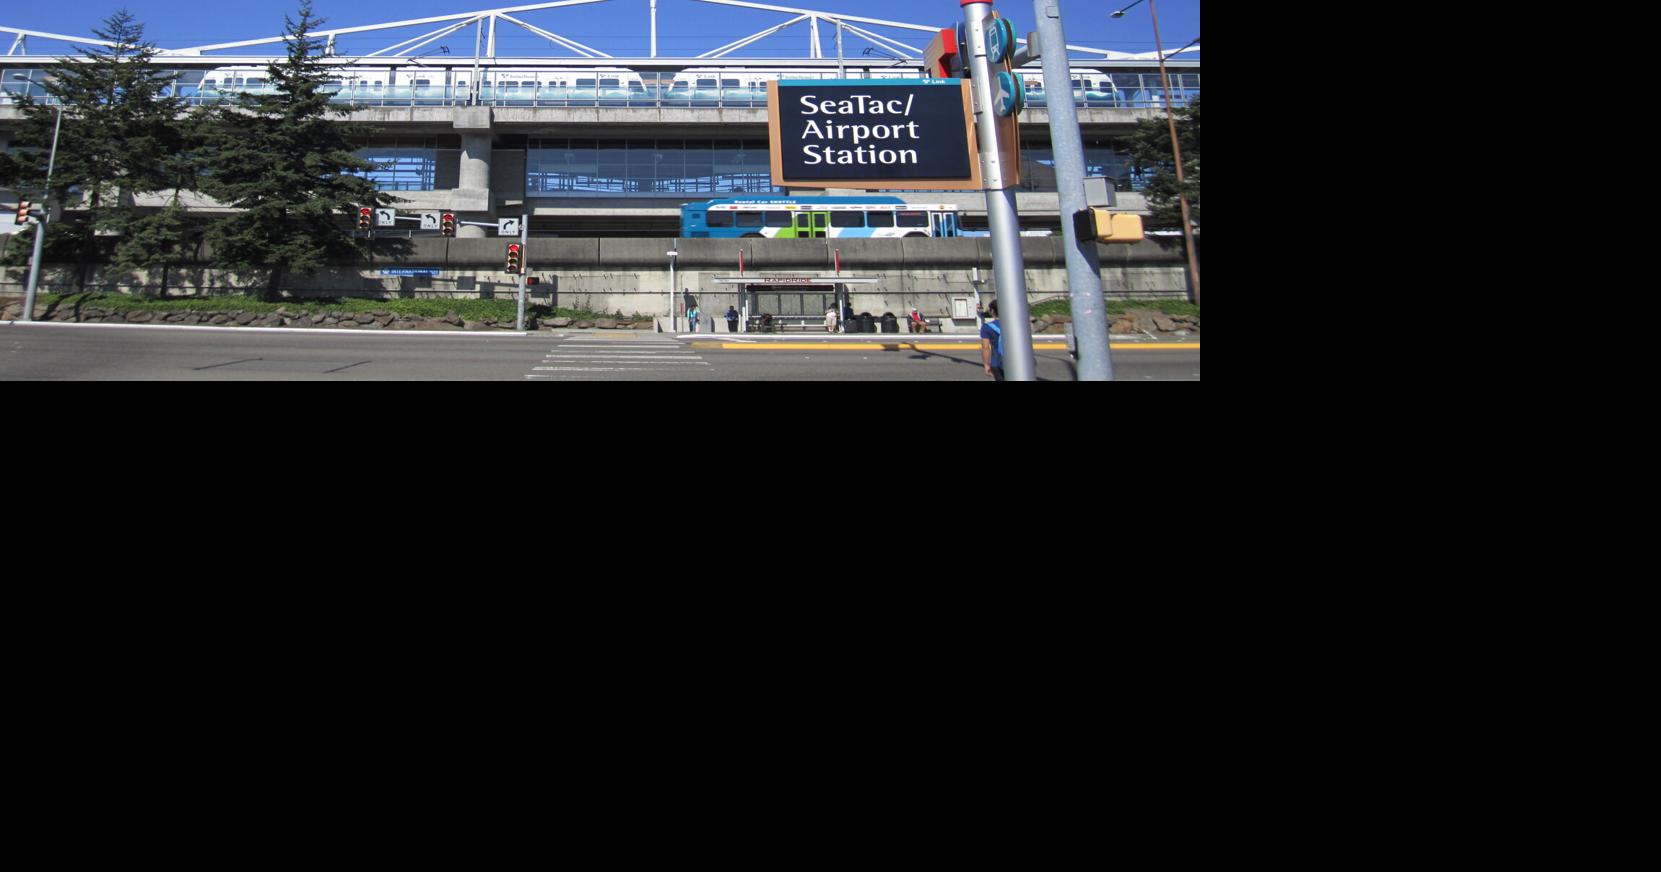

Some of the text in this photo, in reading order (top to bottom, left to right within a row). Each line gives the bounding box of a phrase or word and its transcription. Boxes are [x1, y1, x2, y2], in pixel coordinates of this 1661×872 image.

[800, 94, 914, 116] SeaTac/
[801, 120, 920, 144] Airport
[803, 144, 918, 165] Station
